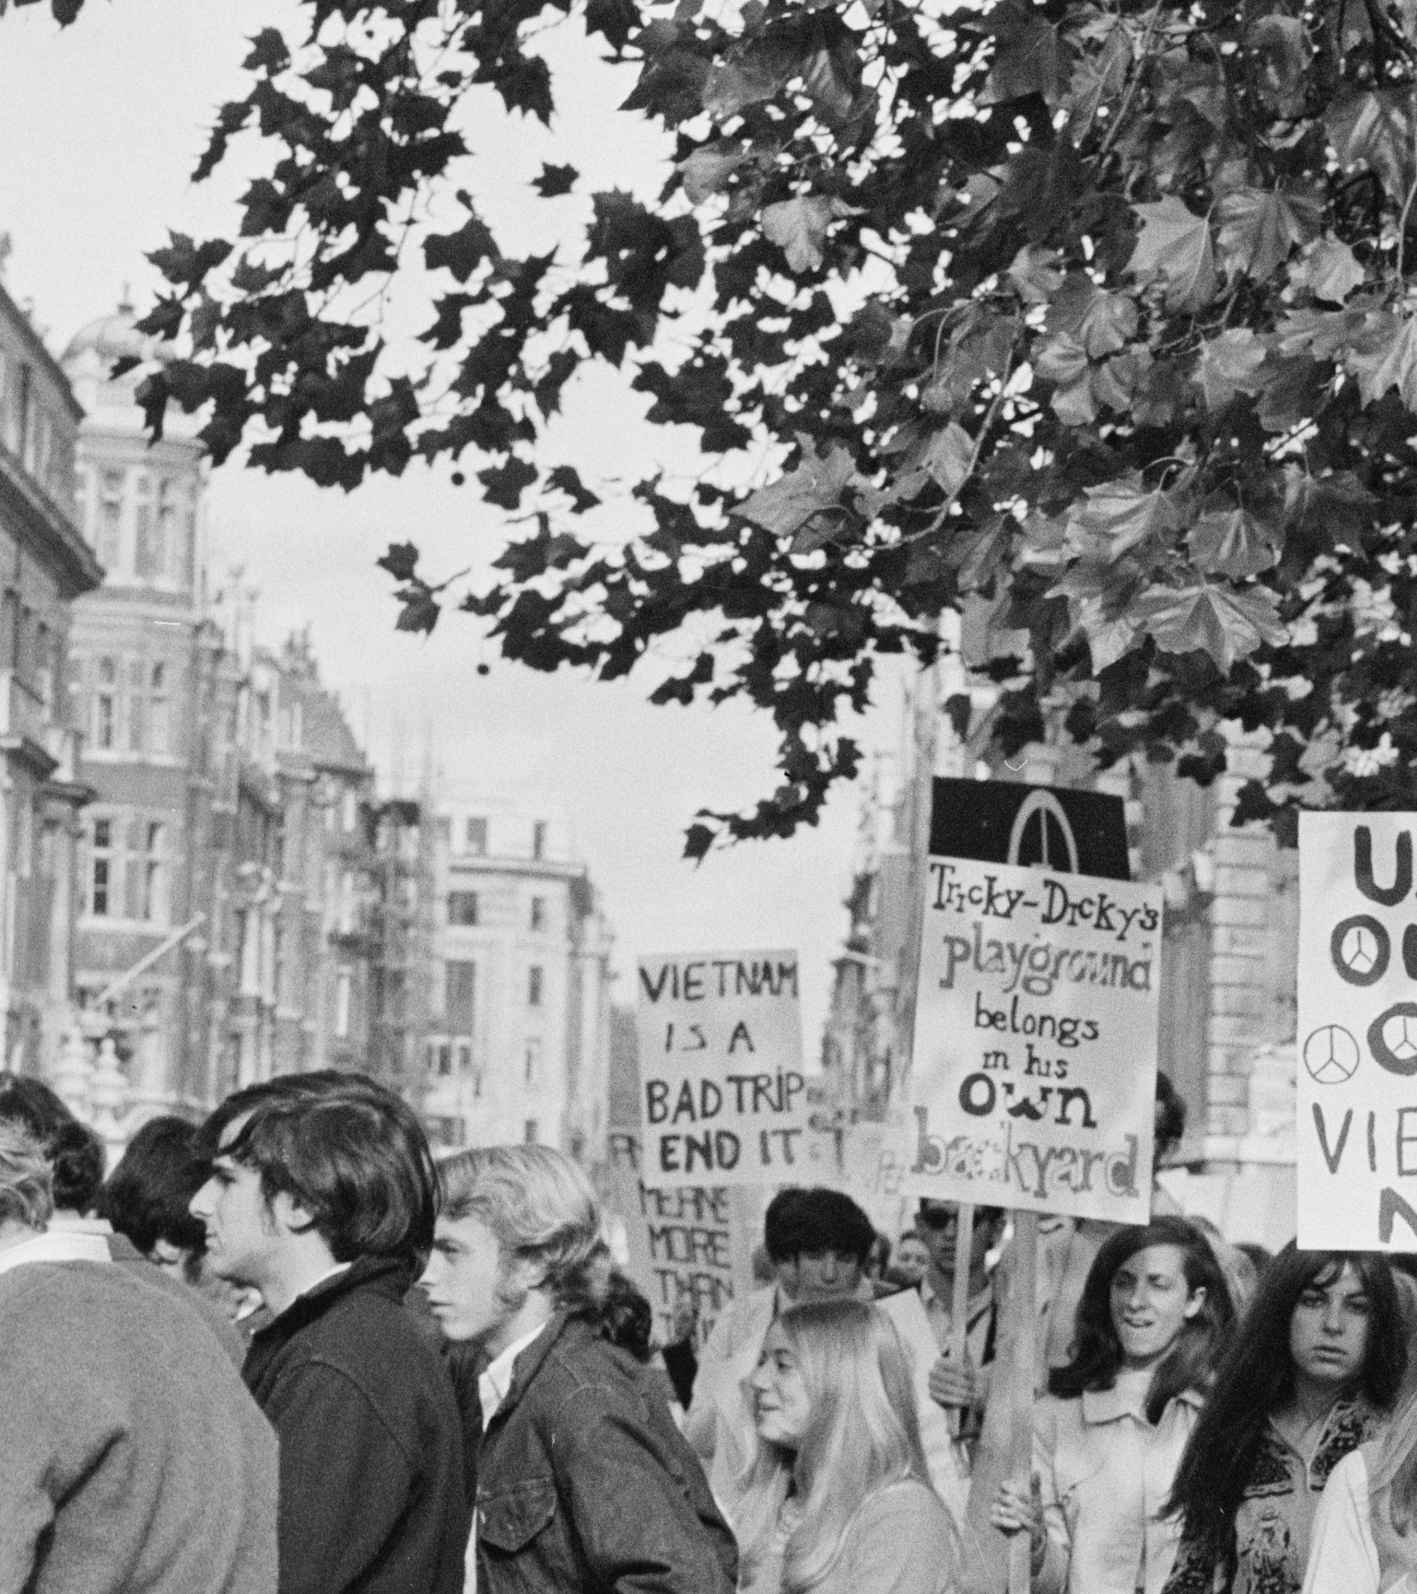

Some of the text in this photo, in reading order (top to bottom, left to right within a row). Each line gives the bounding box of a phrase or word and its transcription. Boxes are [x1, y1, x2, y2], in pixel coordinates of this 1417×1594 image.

[930, 862, 1160, 941] Tricky-Dicky's
[638, 960, 798, 1003] VIETNAM
[938, 921, 1152, 997] playground
[665, 1020, 755, 1054] IS A
[973, 991, 1100, 1049] belongs
[1023, 1043, 1069, 1080] his
[646, 1078, 723, 1124] BAD
[958, 1071, 1097, 1128] own
[660, 1129, 741, 1173] END
[759, 1129, 803, 1166] IT
[910, 1104, 1140, 1199] backyard
[647, 1222, 731, 1270] MORE
